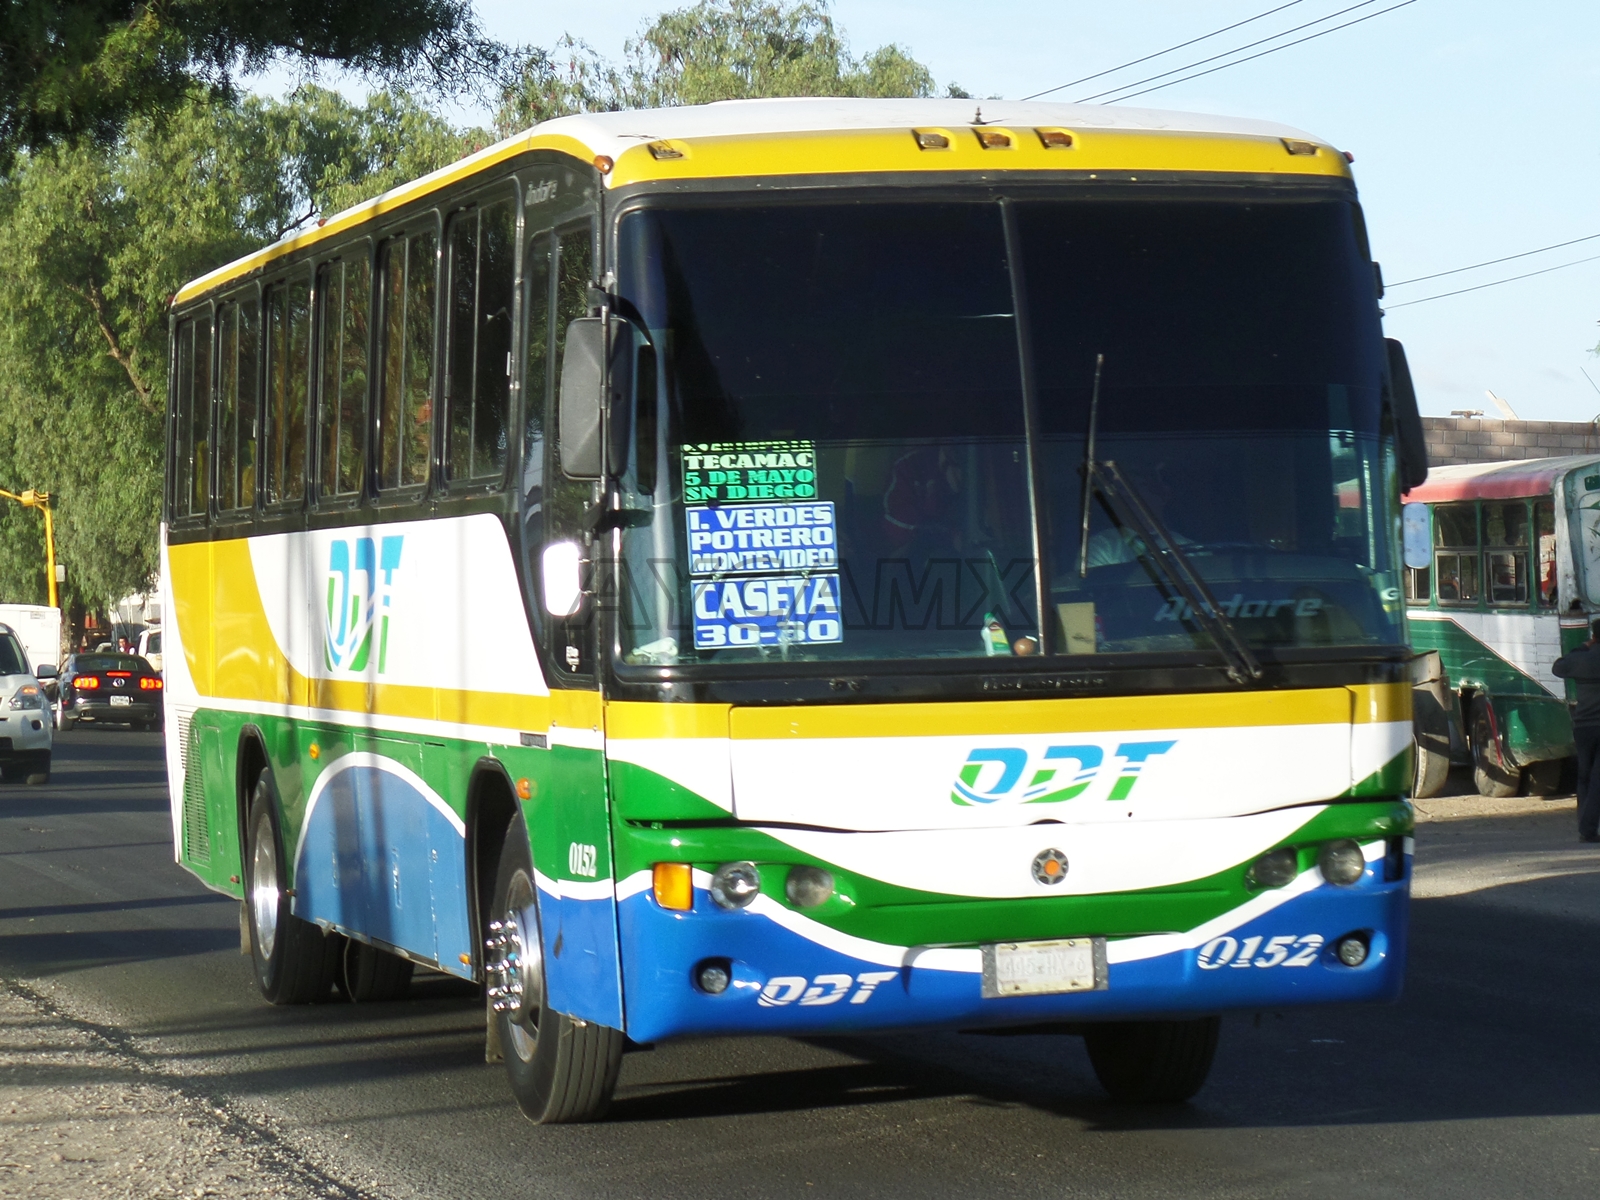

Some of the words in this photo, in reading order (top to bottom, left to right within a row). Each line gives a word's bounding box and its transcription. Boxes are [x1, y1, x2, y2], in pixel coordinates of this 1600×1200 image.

[683, 452, 813, 470] TECAMAC
[685, 471, 701, 486] 5
[708, 470, 741, 485] DE
[747, 469, 814, 484] MAYO
[686, 485, 718, 501] SN
[726, 483, 815, 499] DIEGO
[715, 506, 832, 529] VERDES
[691, 526, 834, 551] POTRERO
[691, 547, 835, 572] MONTEVIDEO
[695, 578, 838, 620] CASETA
[568, 841, 597, 878] 0152
[1197, 933, 1325, 970] 0152
